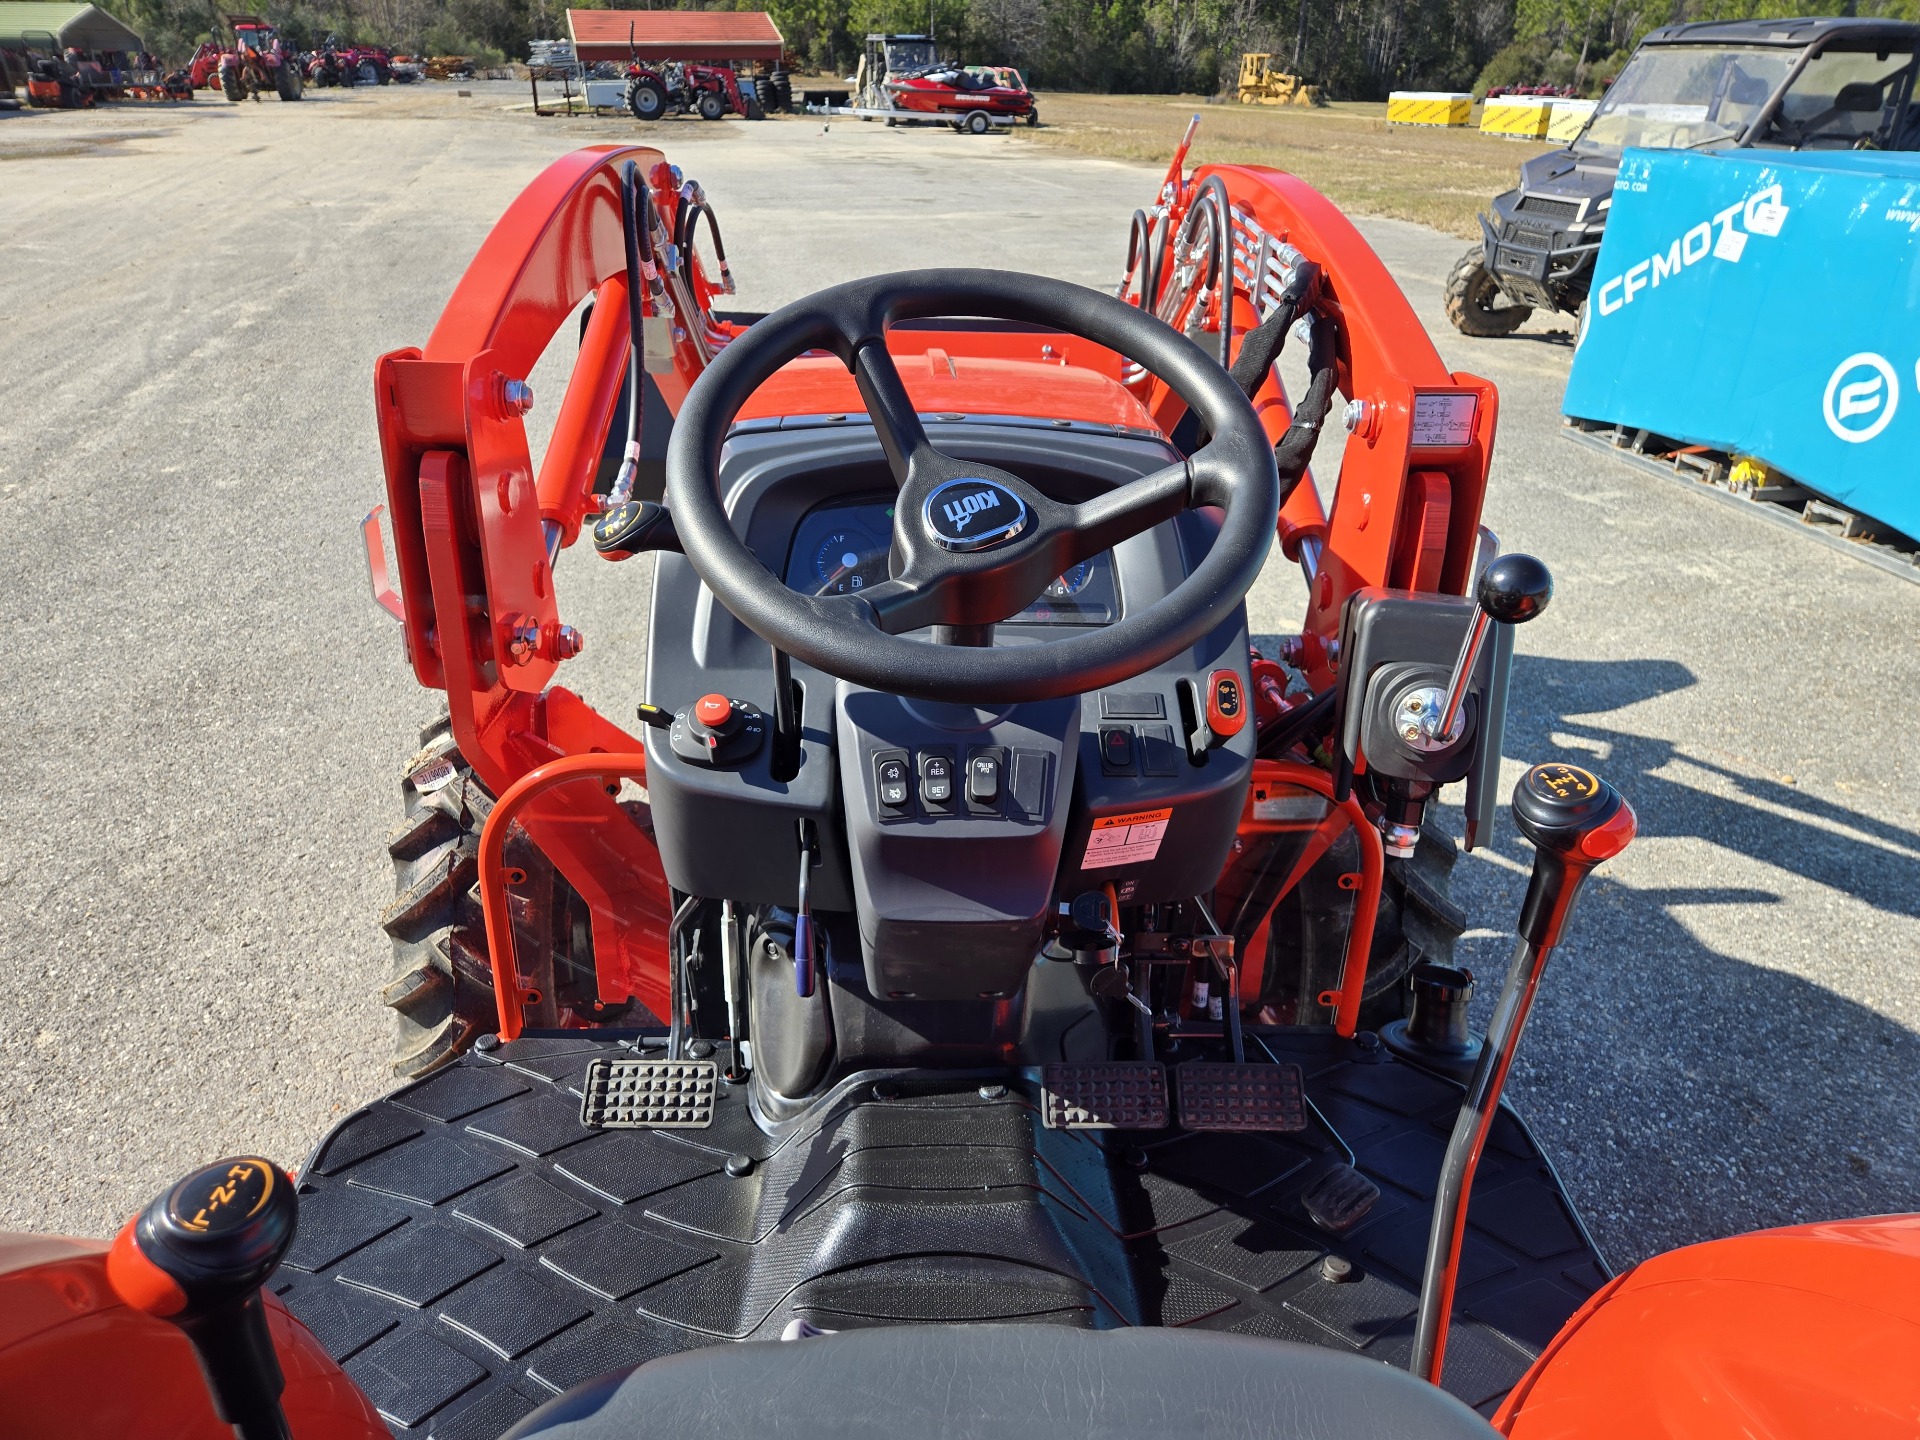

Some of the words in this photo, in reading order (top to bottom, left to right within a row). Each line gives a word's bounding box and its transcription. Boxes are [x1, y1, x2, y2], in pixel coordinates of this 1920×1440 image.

[1598, 183, 1783, 317] CFMOTO
[838, 584, 844, 592] E
[1057, 586, 1064, 595] C
[976, 761, 994, 769] CRUISE
[930, 768, 945, 776] RES
[931, 786, 945, 794] SET
[1556, 788, 1570, 798] 2
[1117, 812, 1162, 824] WARNING
[192, 1208, 210, 1227] L
